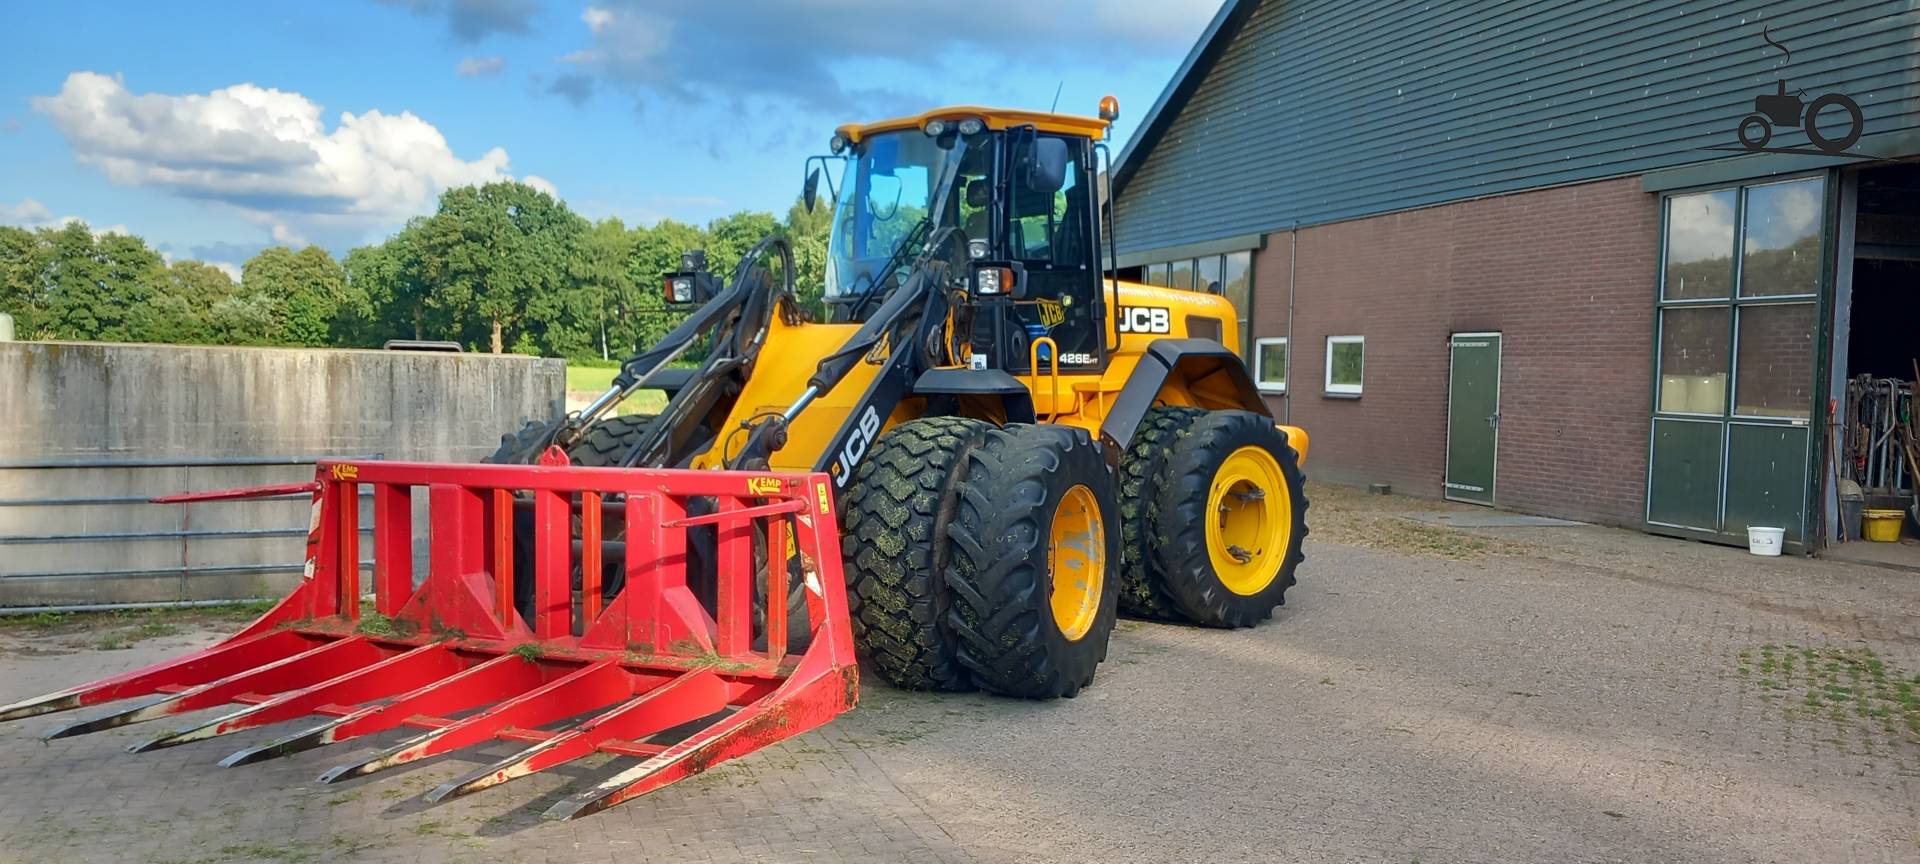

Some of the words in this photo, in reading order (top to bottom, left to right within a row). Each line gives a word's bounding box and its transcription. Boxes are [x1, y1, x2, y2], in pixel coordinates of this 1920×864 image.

[1041, 302, 1063, 327] JCB
[1119, 307, 1169, 333] JCB
[836, 405, 880, 488] JCB
[332, 464, 358, 480] KEMP
[747, 478, 782, 496] KEMP
